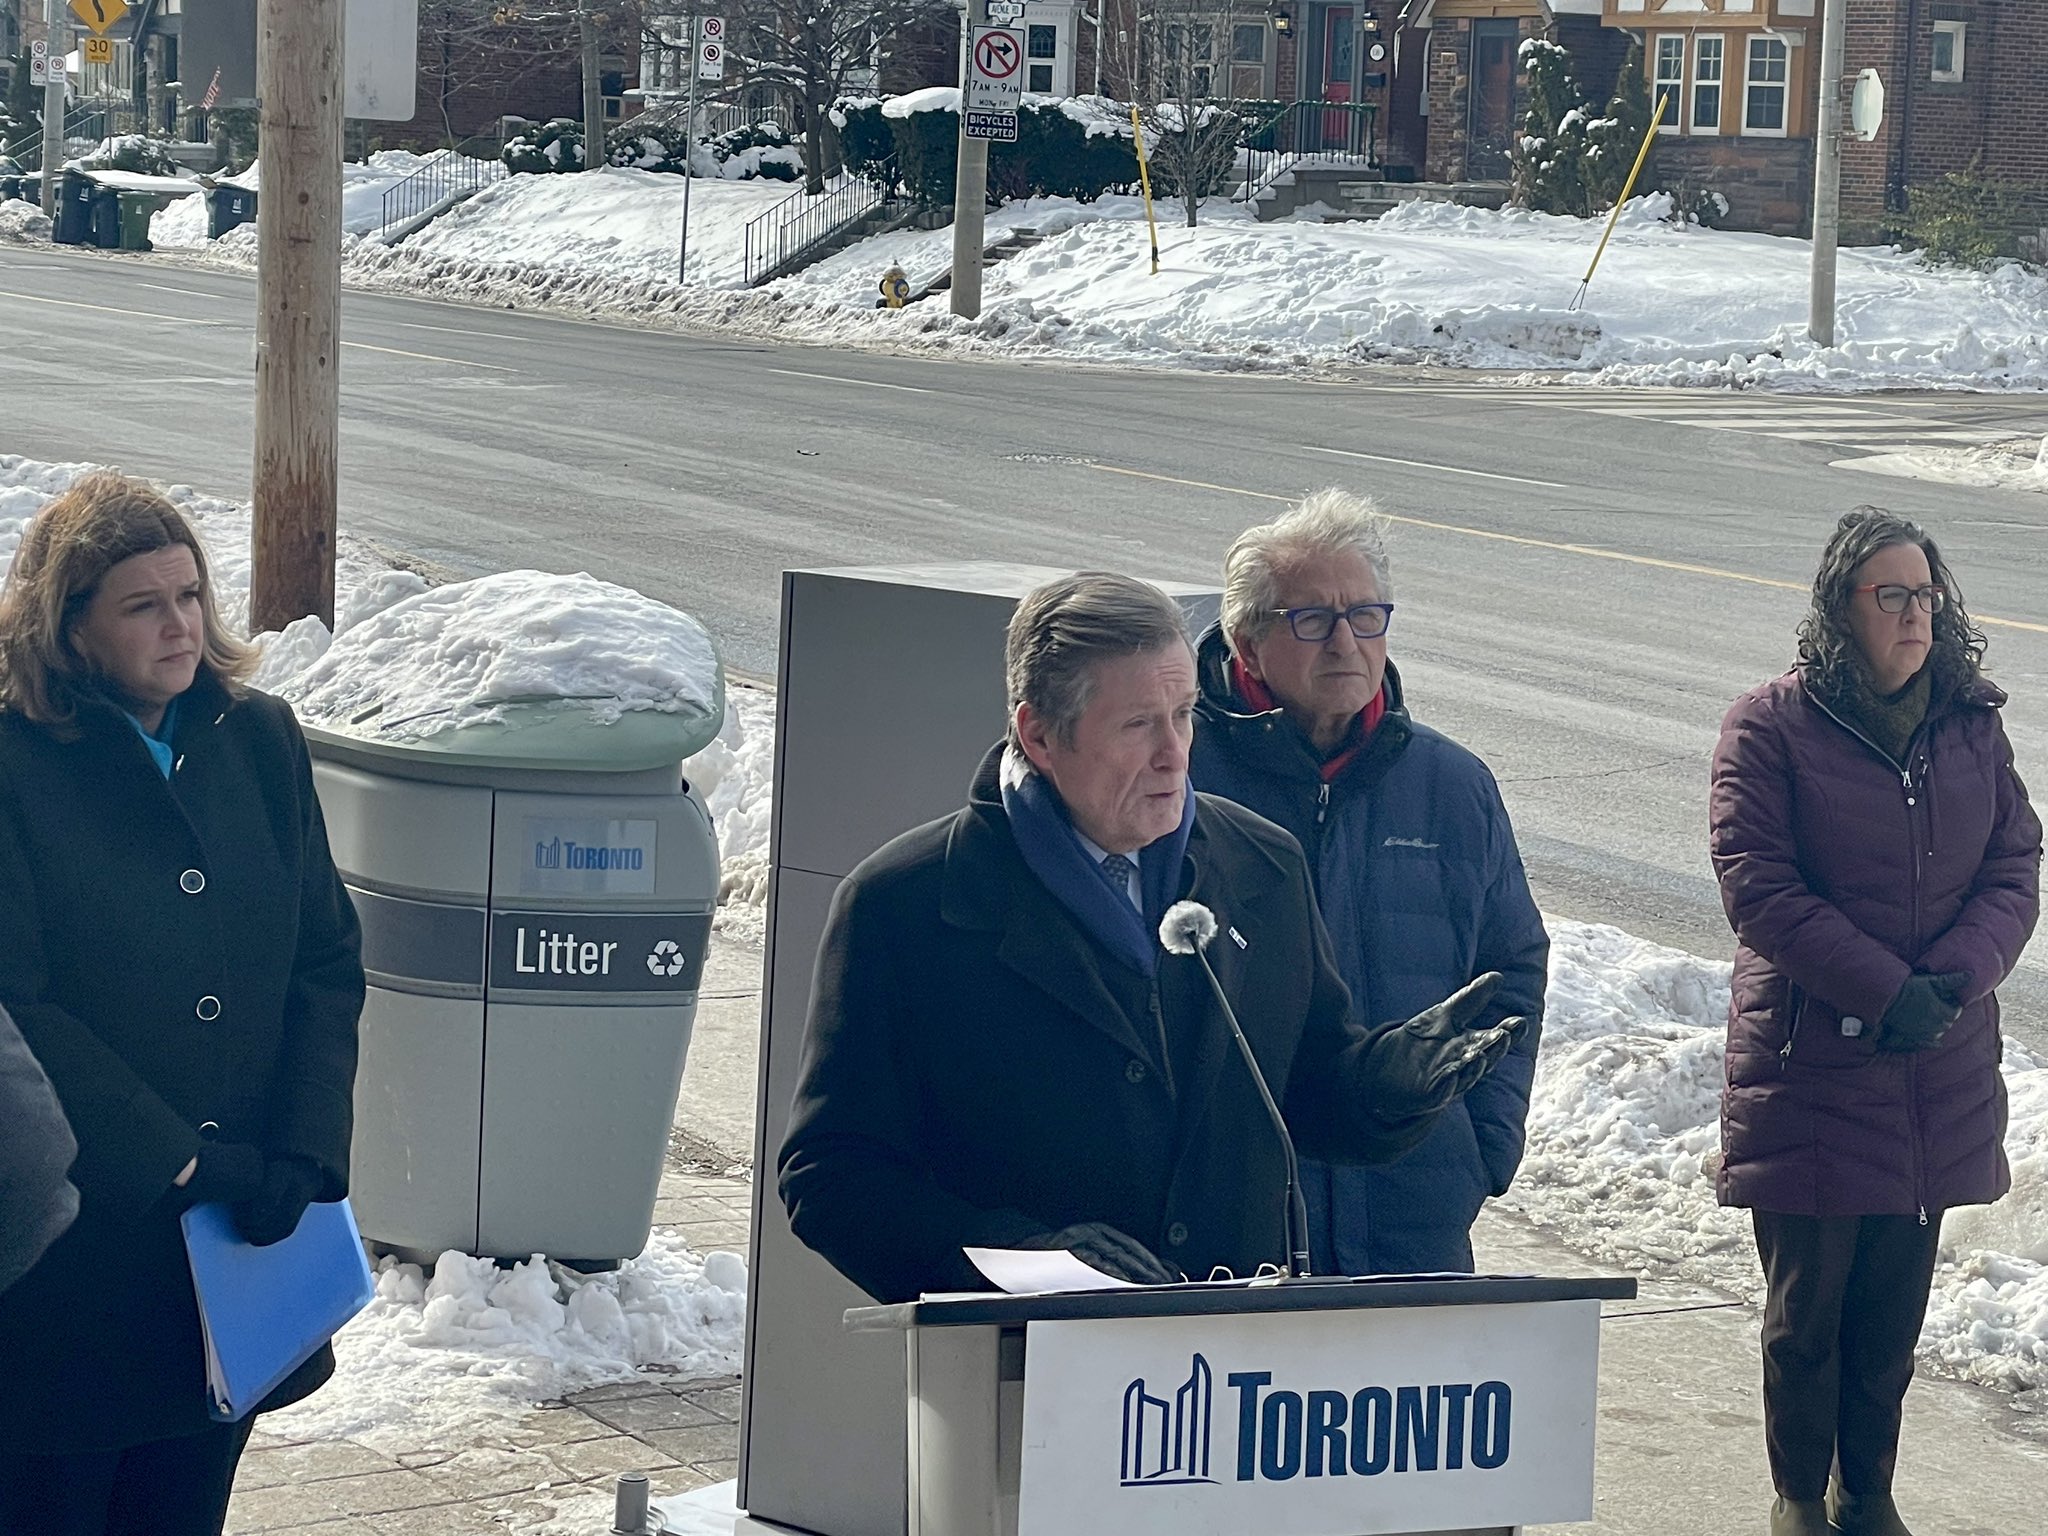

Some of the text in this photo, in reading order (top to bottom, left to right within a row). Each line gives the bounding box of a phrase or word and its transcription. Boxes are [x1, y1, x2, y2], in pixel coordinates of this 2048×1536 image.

[89, 40, 108, 53] 30
[970, 115, 1014, 127] BICYCLES
[968, 126, 1014, 138] EXCEPTED
[564, 842, 643, 870] TORONTO
[516, 928, 618, 975] Litter
[1228, 1371, 1512, 1481] TORONTO
